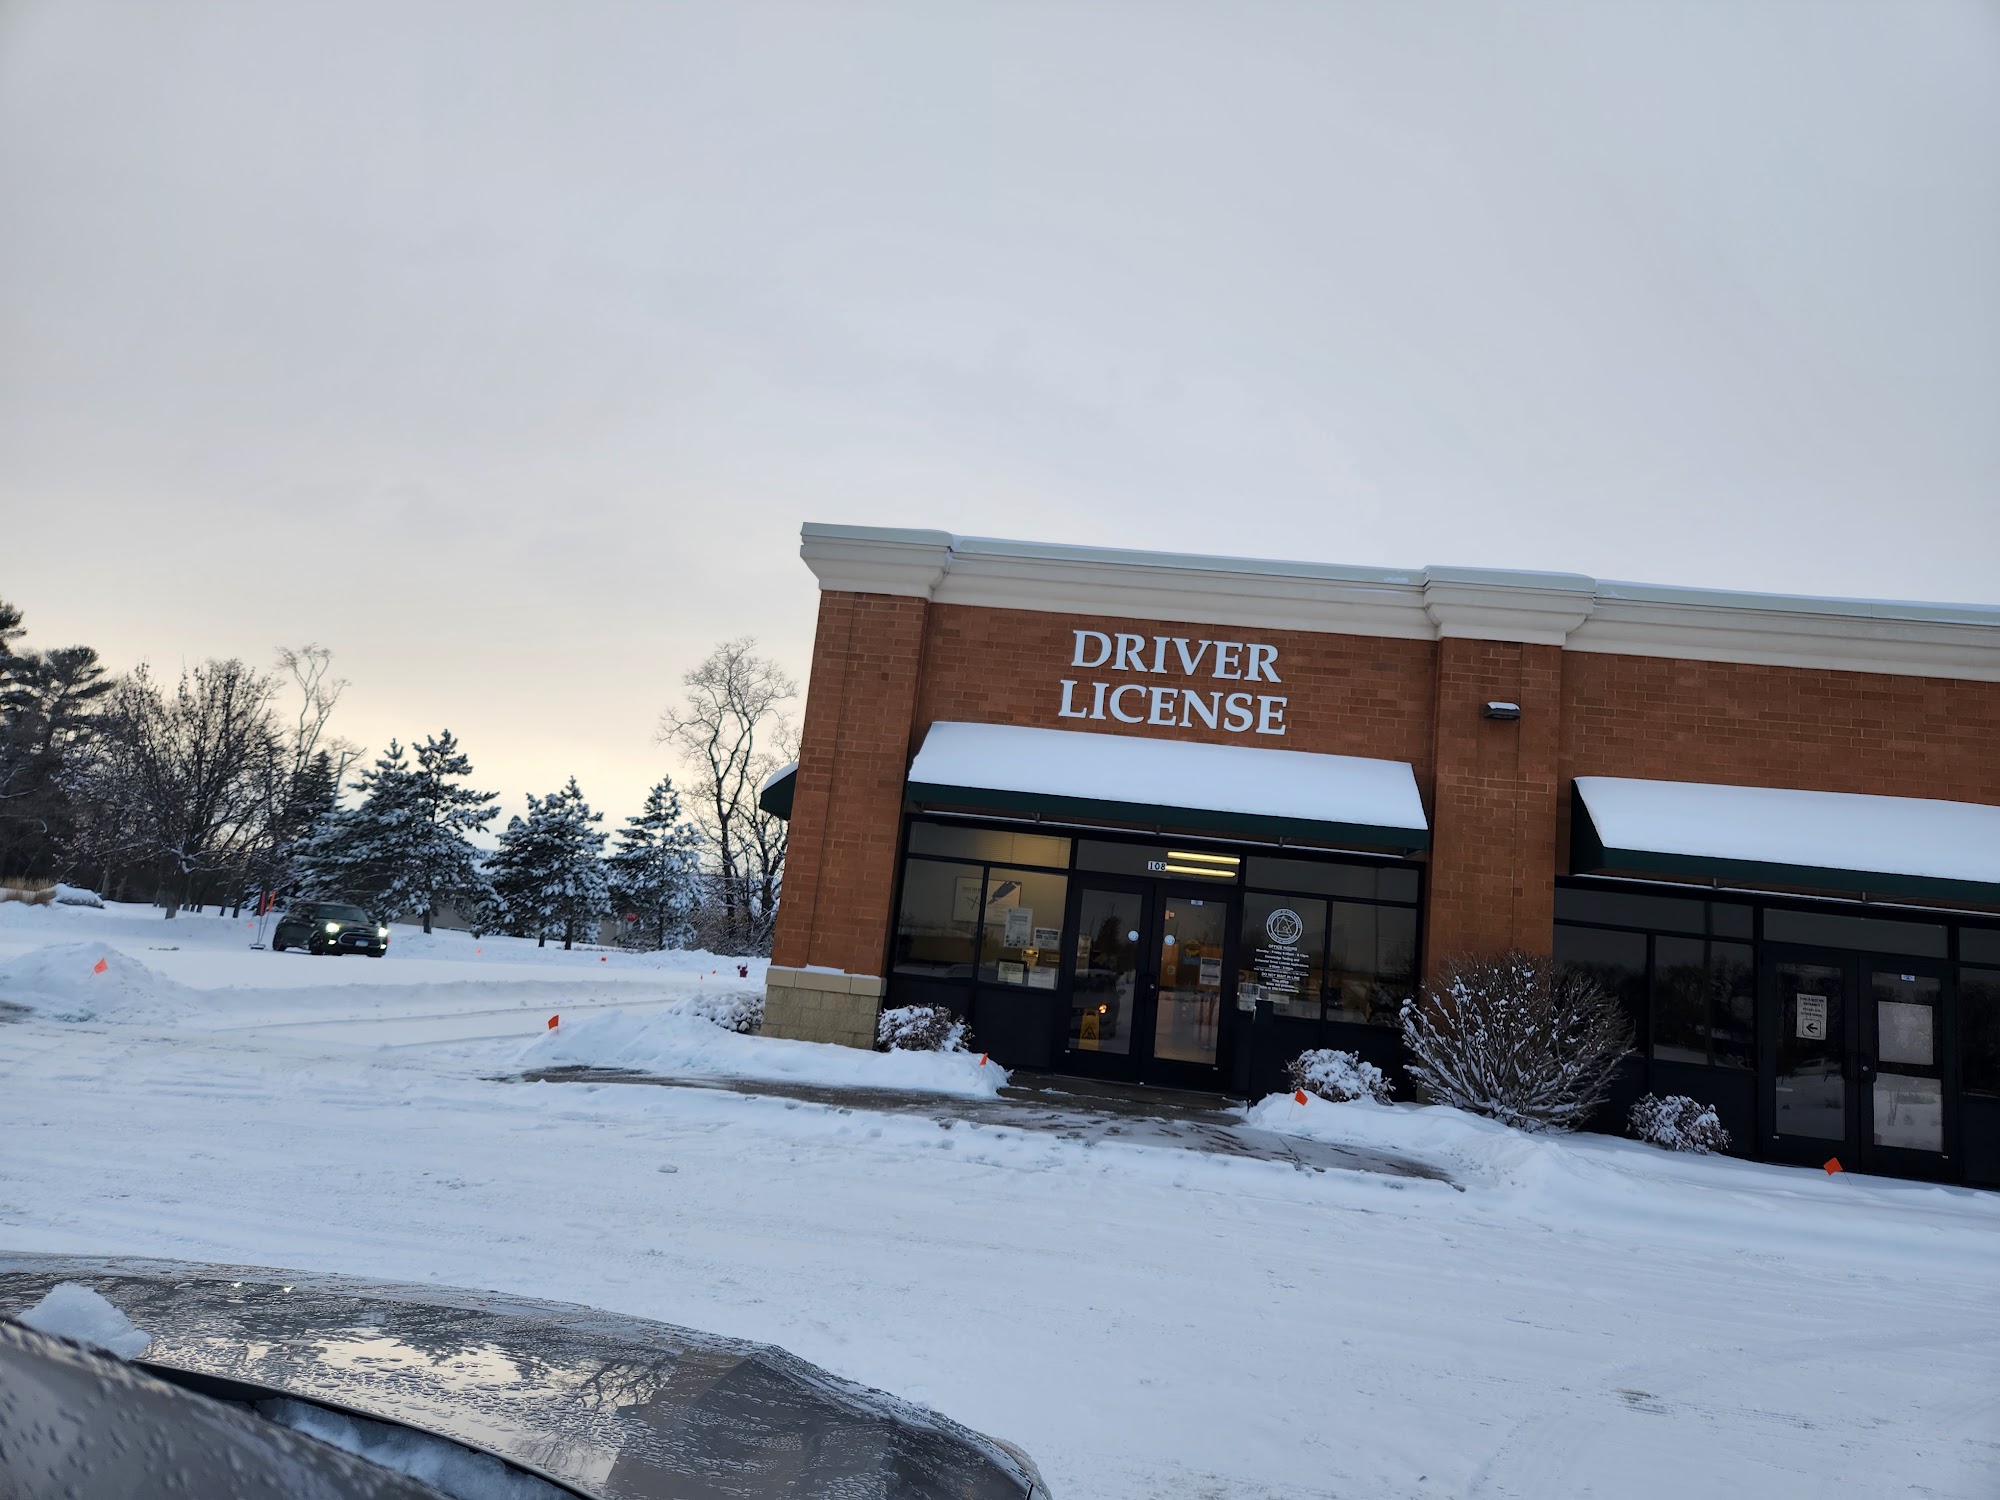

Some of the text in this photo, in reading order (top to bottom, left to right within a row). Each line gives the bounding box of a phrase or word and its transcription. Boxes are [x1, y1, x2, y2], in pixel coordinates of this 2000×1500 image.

[1071, 630, 1281, 682] DRIVER
[1058, 679, 1288, 735] LICENSE
[1150, 862, 1166, 871] 108
